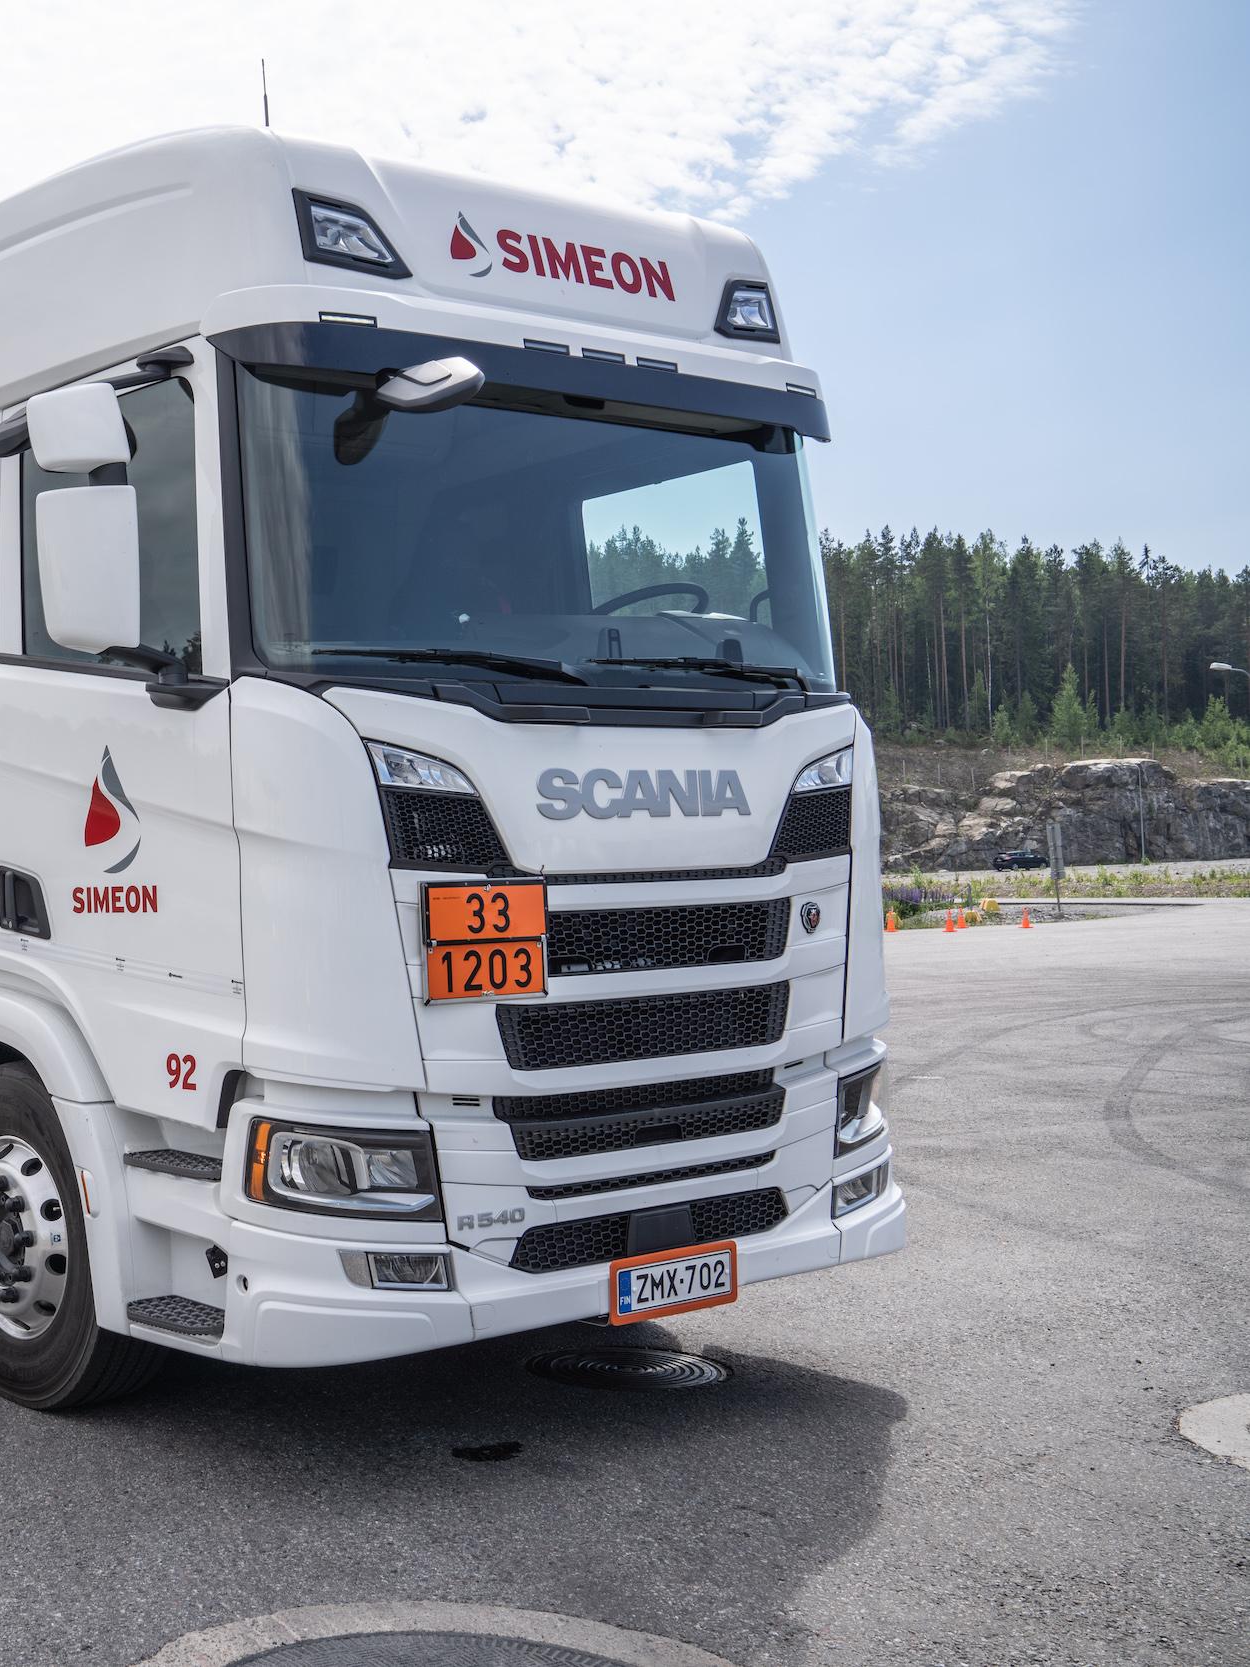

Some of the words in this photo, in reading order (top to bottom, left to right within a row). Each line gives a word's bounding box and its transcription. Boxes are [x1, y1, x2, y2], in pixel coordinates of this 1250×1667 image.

[496, 229, 676, 302] SIMEON
[536, 768, 751, 820] SCANIA
[72, 885, 158, 914] SIMEON
[466, 892, 510, 934] 33
[441, 948, 533, 993] 1203
[166, 1053, 197, 1090] 92
[477, 1207, 525, 1228] 540
[619, 1295, 631, 1306] FIN
[636, 1260, 725, 1304] ZMX-702
